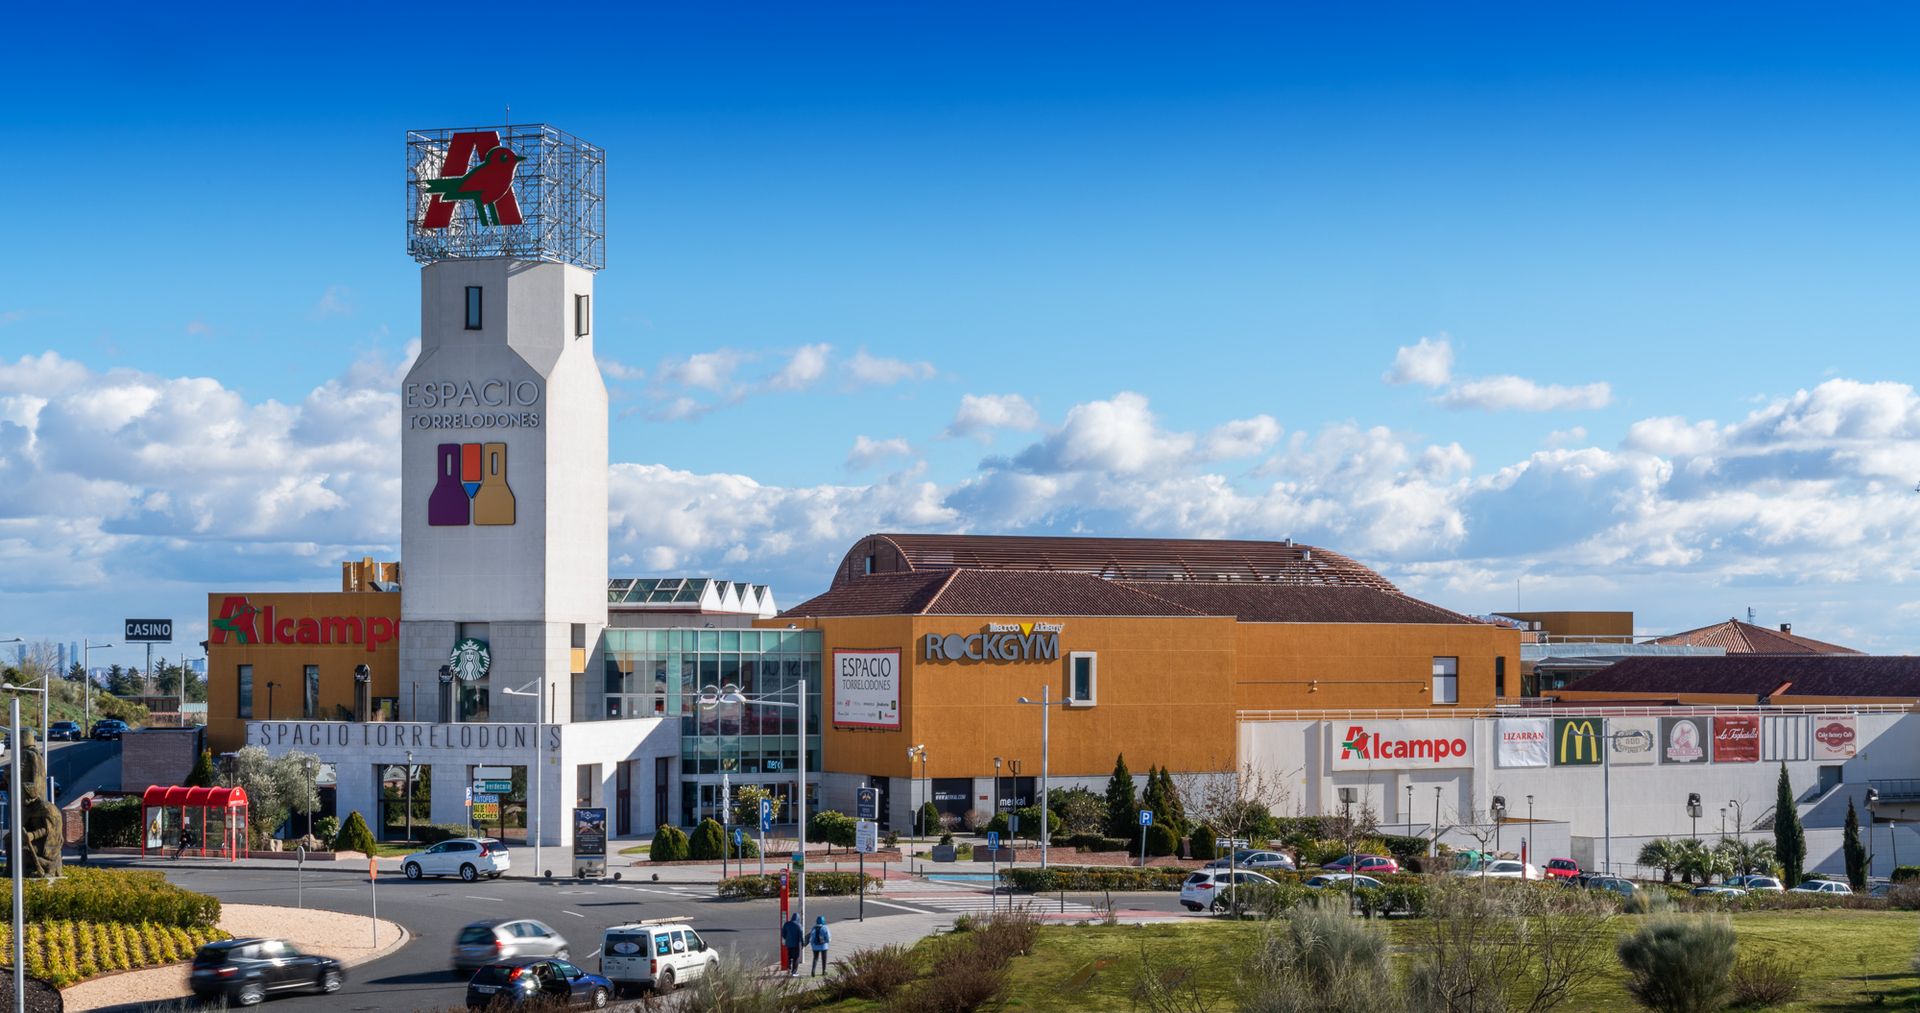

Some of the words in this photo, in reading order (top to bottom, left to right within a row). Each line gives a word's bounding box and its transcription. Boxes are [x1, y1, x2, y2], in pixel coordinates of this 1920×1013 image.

[406, 380, 540, 408] ESPACIO
[409, 412, 540, 430] TORRELODONES
[126, 622, 171, 636] CASINO
[926, 632, 1060, 660] ROCKGYM
[842, 657, 892, 678] ESPACIO
[842, 679, 892, 691] TORRELODONES
[246, 723, 349, 746] ESPACIO
[1503, 731, 1544, 741] LIZARRAN
[1341, 726, 1467, 762] Alcampo
[763, 801, 769, 815] P
[1142, 812, 1150, 824] P
